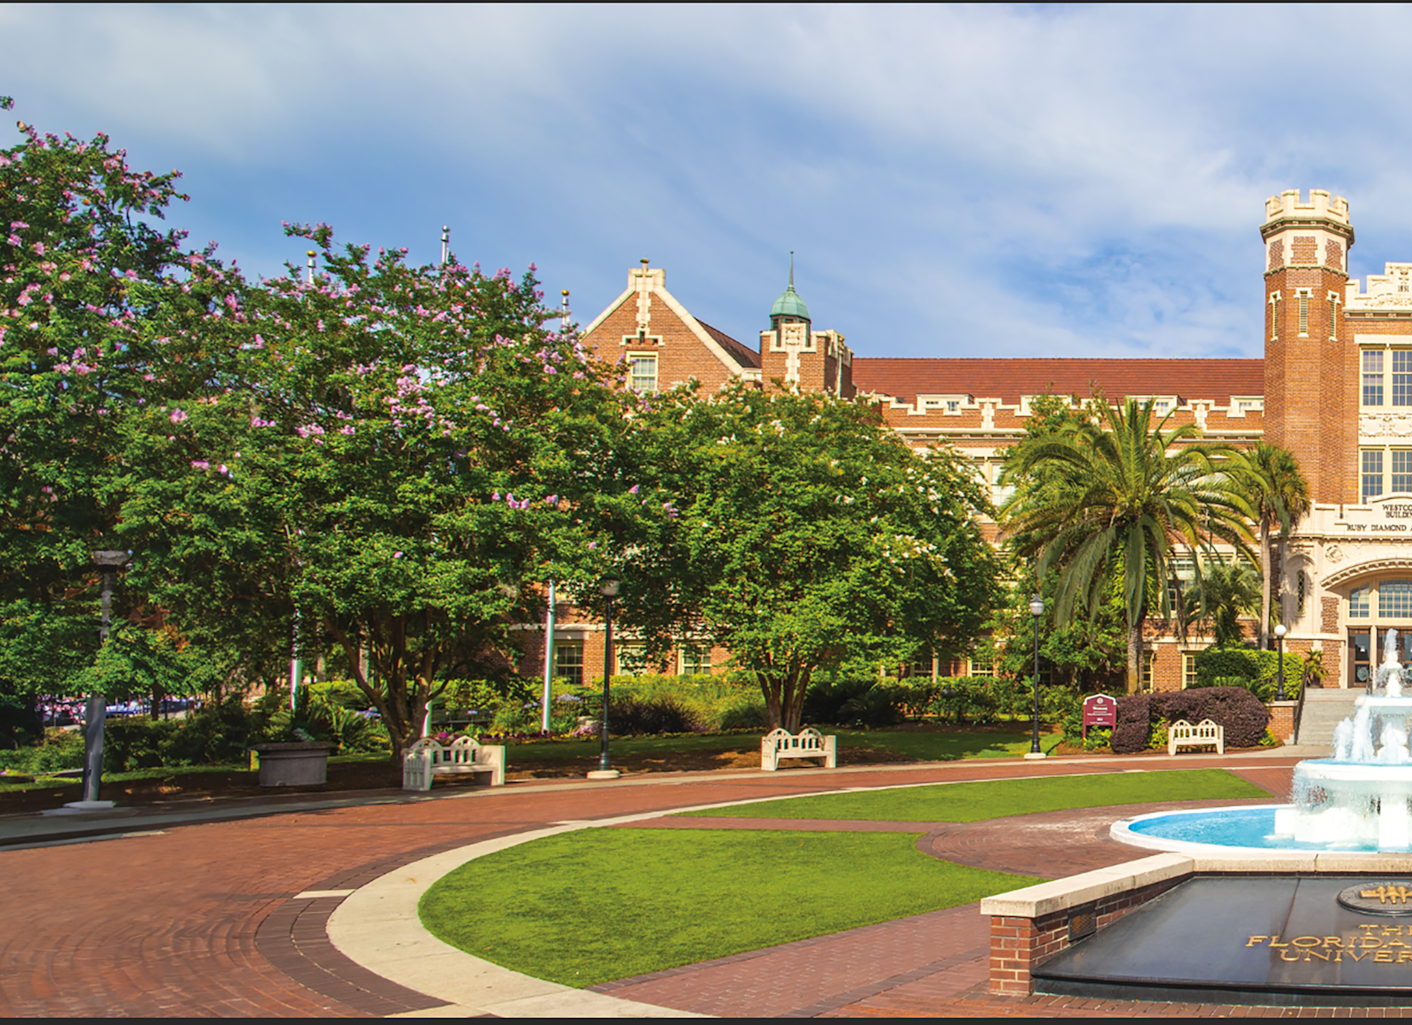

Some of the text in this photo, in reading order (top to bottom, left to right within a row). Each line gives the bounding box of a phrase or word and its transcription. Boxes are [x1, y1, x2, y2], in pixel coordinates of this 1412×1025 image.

[1347, 524, 1367, 532] RUBY
[1371, 524, 1407, 532] DIAMOND
[1245, 935, 1412, 949] FLORIDA
